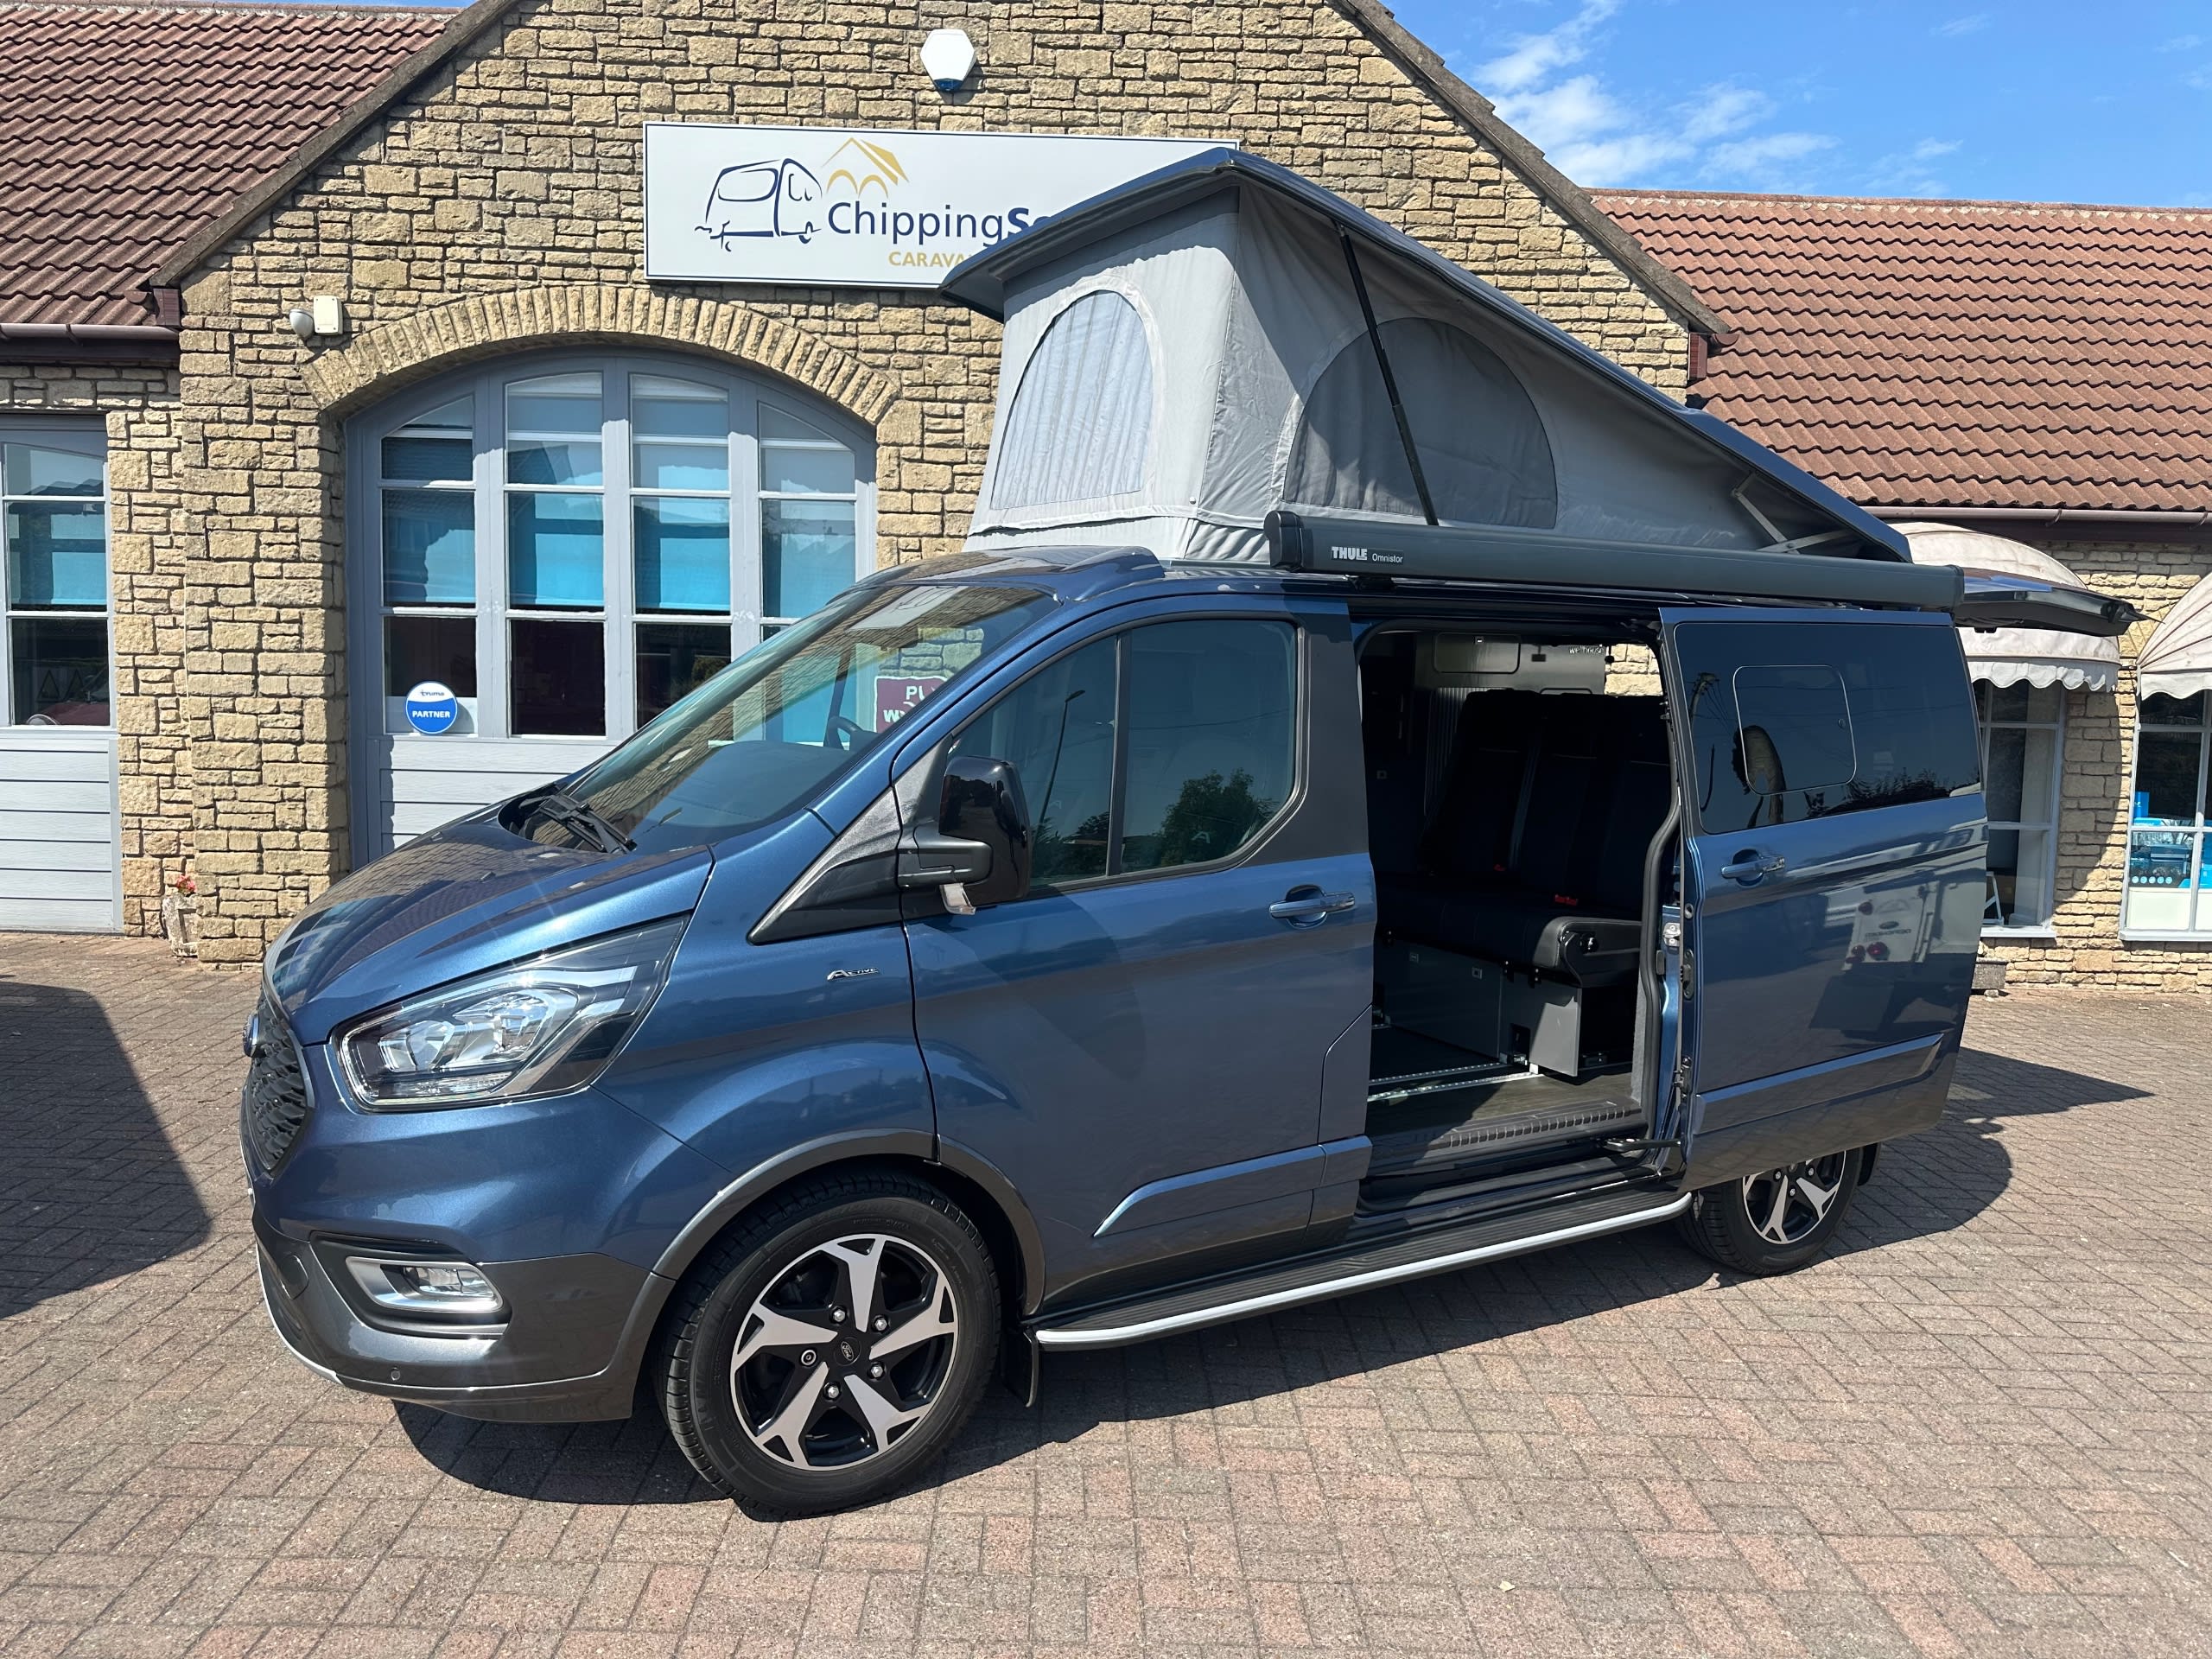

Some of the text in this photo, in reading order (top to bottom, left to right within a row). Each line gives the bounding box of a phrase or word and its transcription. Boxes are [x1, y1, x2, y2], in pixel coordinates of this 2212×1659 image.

[888, 251, 972, 267] CARAVA
[1332, 546, 1403, 563] THULE Omnistor
